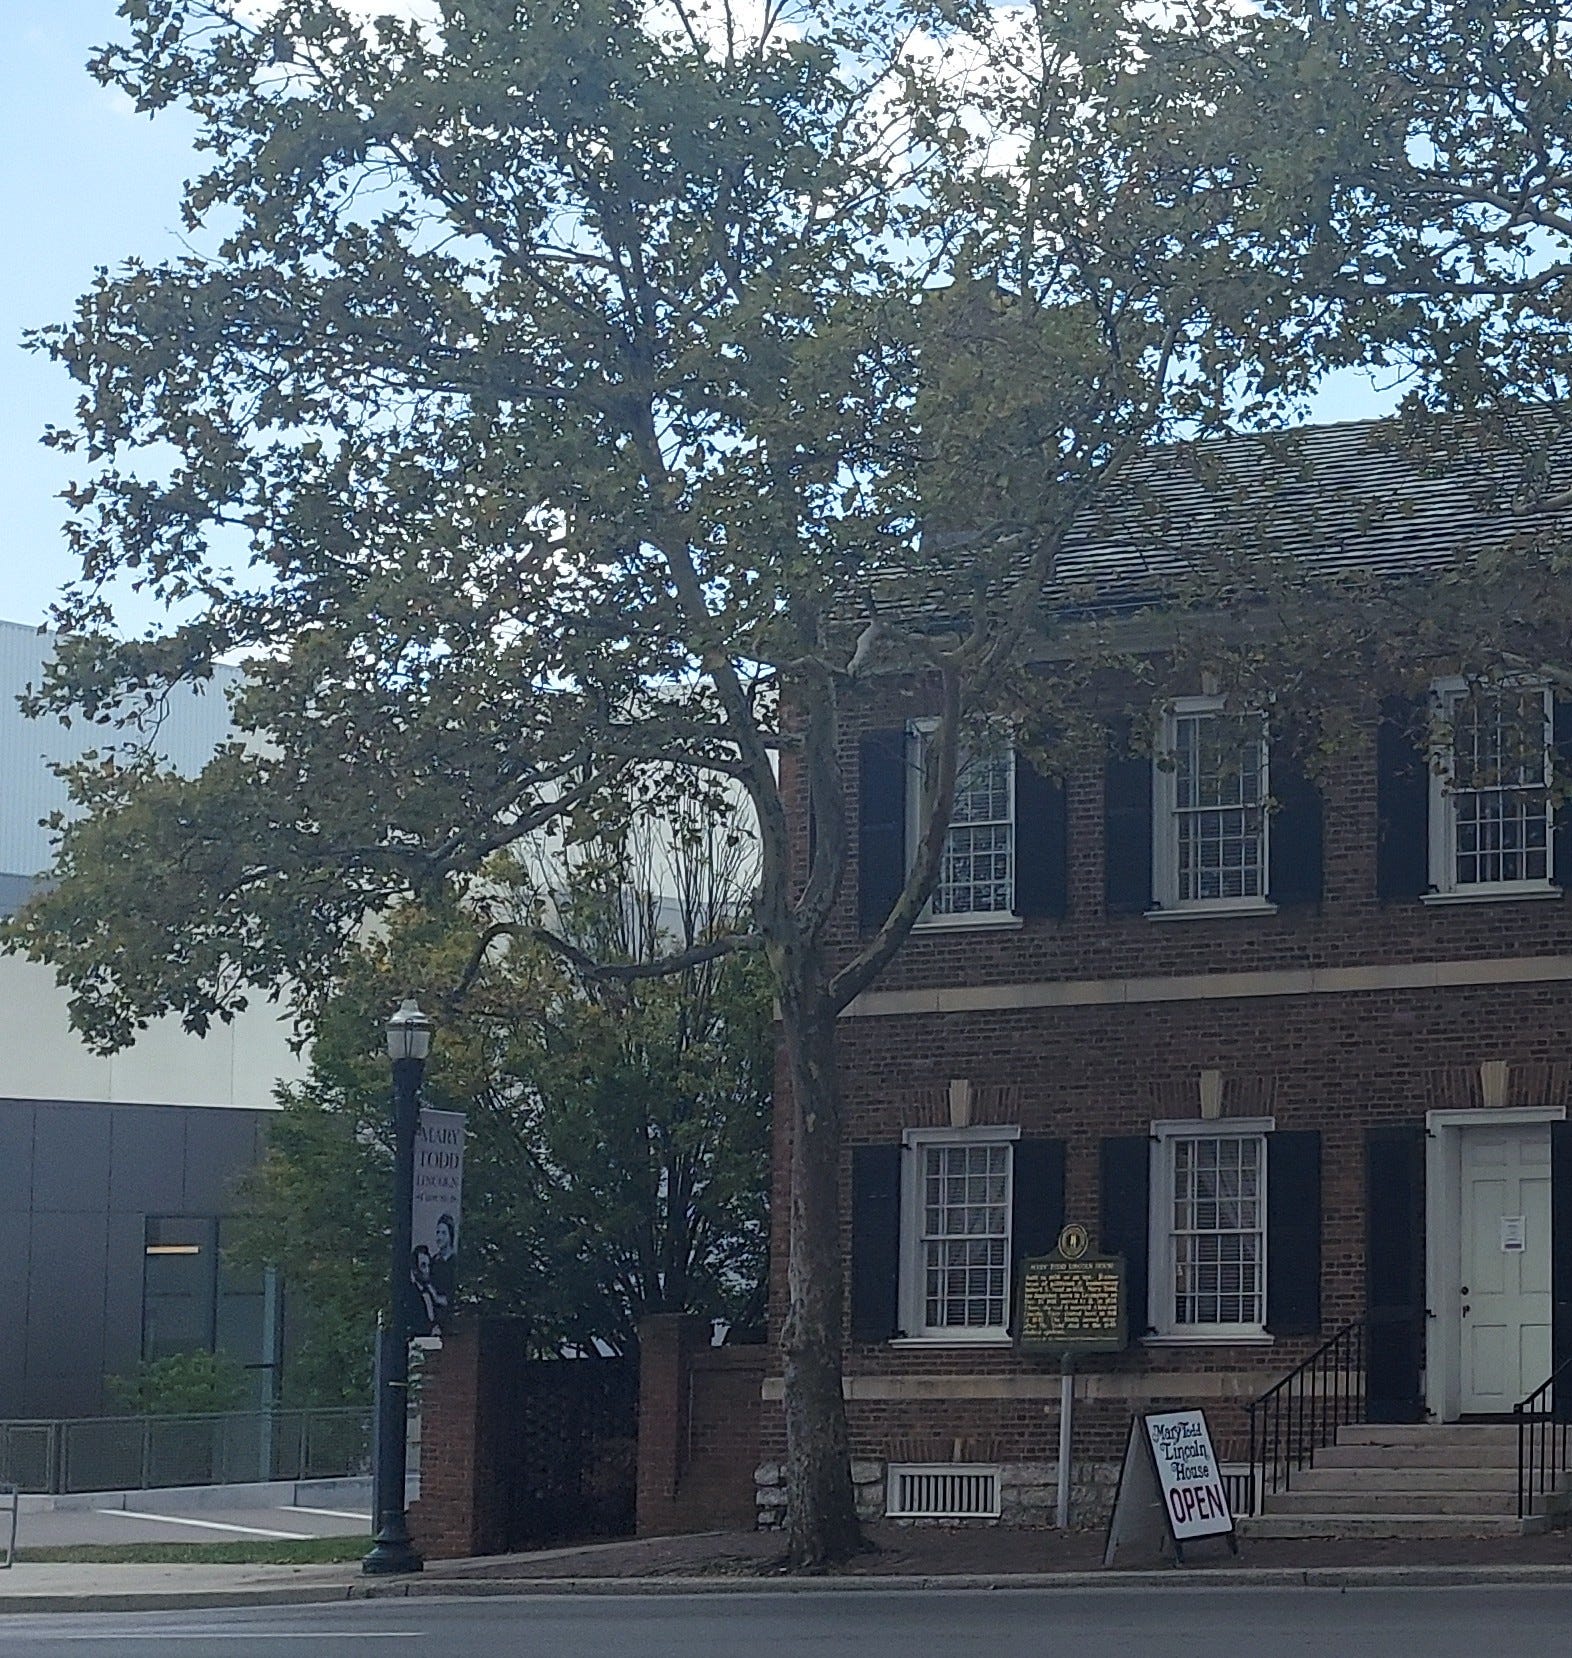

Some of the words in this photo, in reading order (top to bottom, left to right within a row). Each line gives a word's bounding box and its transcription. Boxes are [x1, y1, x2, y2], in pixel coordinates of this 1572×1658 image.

[420, 1151, 459, 1169] TODD
[1153, 1424, 1182, 1443] Mary
[1178, 1421, 1202, 1438] Todd
[1160, 1440, 1210, 1461] Lincoln
[1171, 1461, 1209, 1481] House
[1169, 1484, 1226, 1524] OPEN
